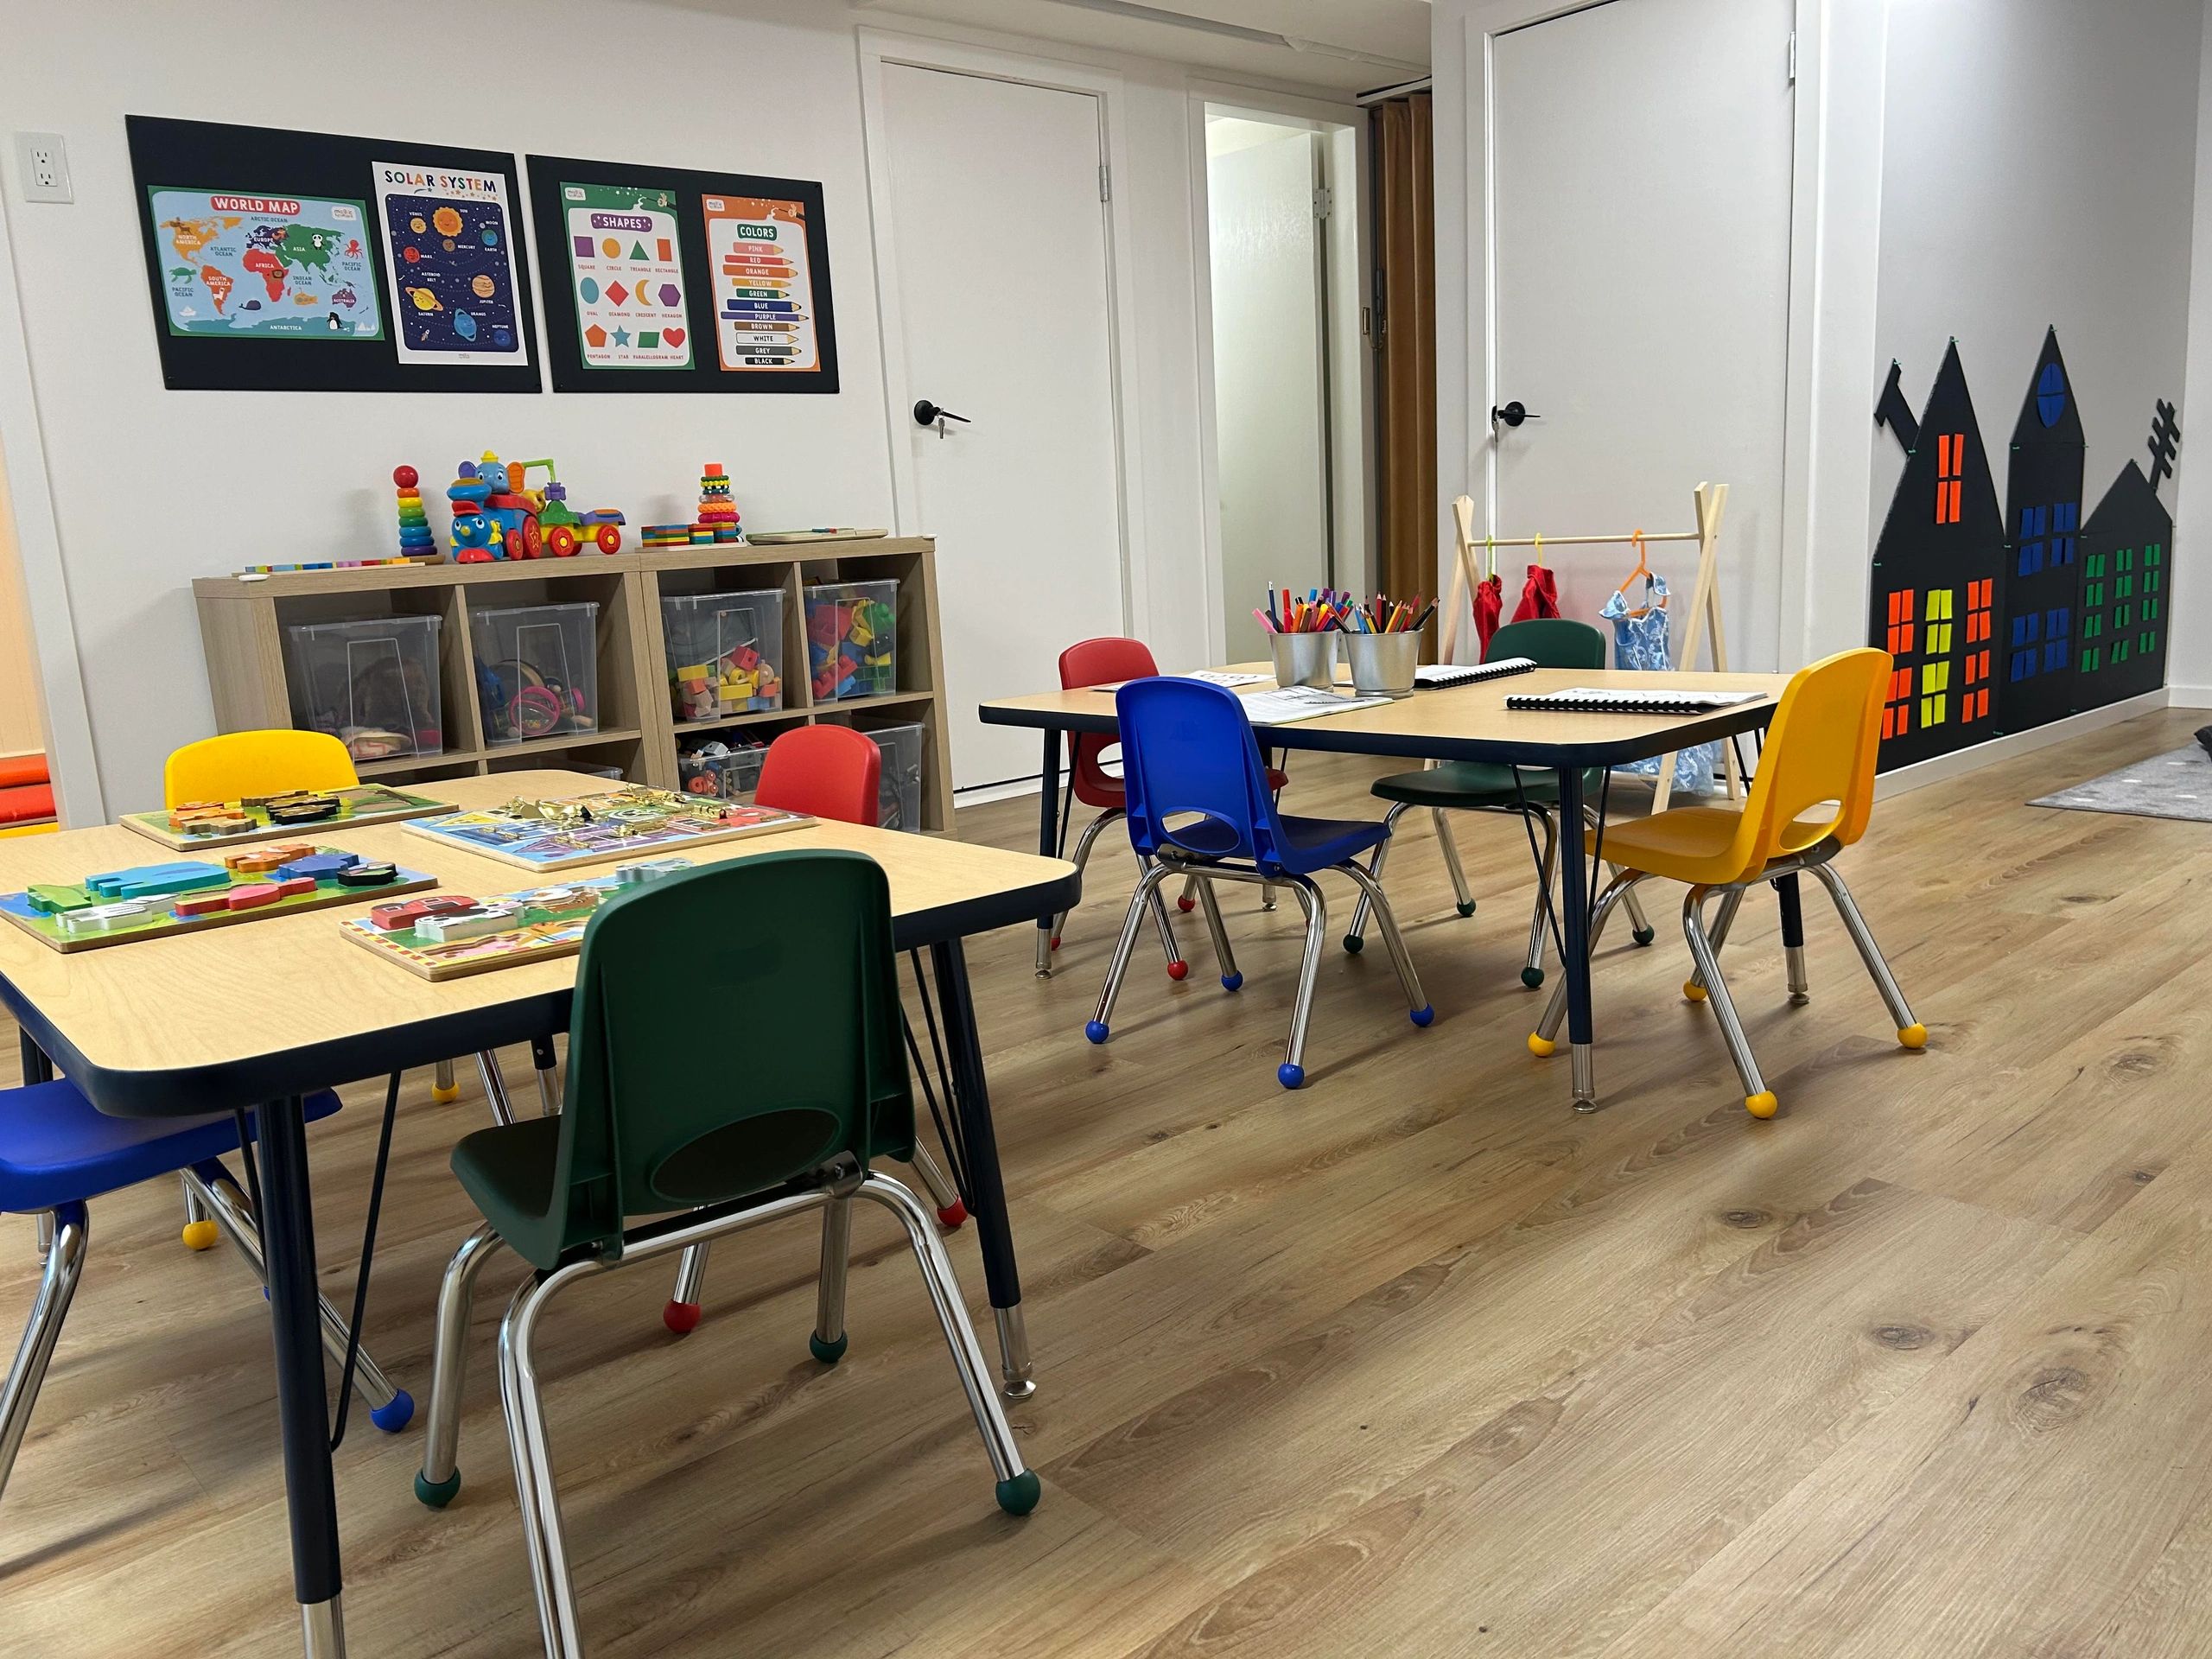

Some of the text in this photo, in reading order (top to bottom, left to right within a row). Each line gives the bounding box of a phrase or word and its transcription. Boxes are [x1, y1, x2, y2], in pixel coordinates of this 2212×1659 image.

[385, 169, 497, 193] SOLAR SYSTEM
[213, 197, 298, 213] WORLD MAP
[602, 216, 642, 229] SHAPES
[740, 226, 774, 238] COLORS
